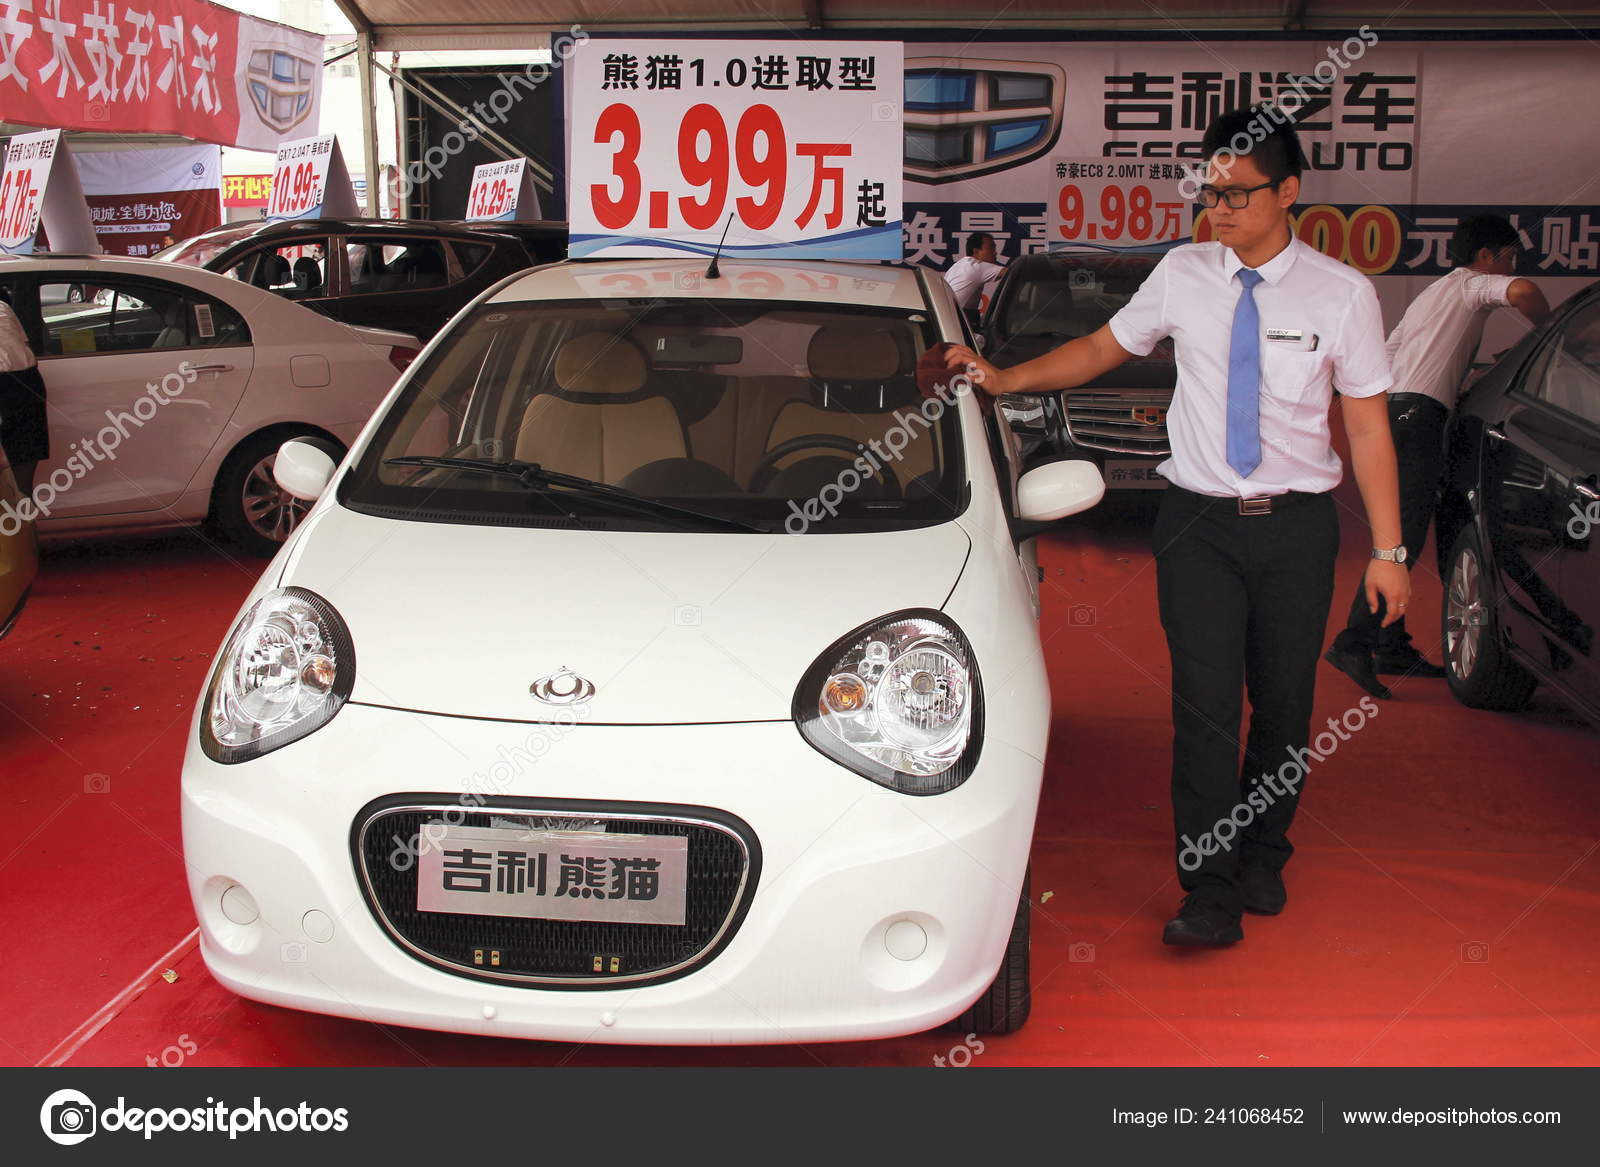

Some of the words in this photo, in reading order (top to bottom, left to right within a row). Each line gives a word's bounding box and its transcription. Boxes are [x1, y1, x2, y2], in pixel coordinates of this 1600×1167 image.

[601, 54, 877, 91] 熊猫1.0进取型
[1107, 164, 1145, 178] 2.0MT
[1058, 184, 1184, 240] 9.98万
